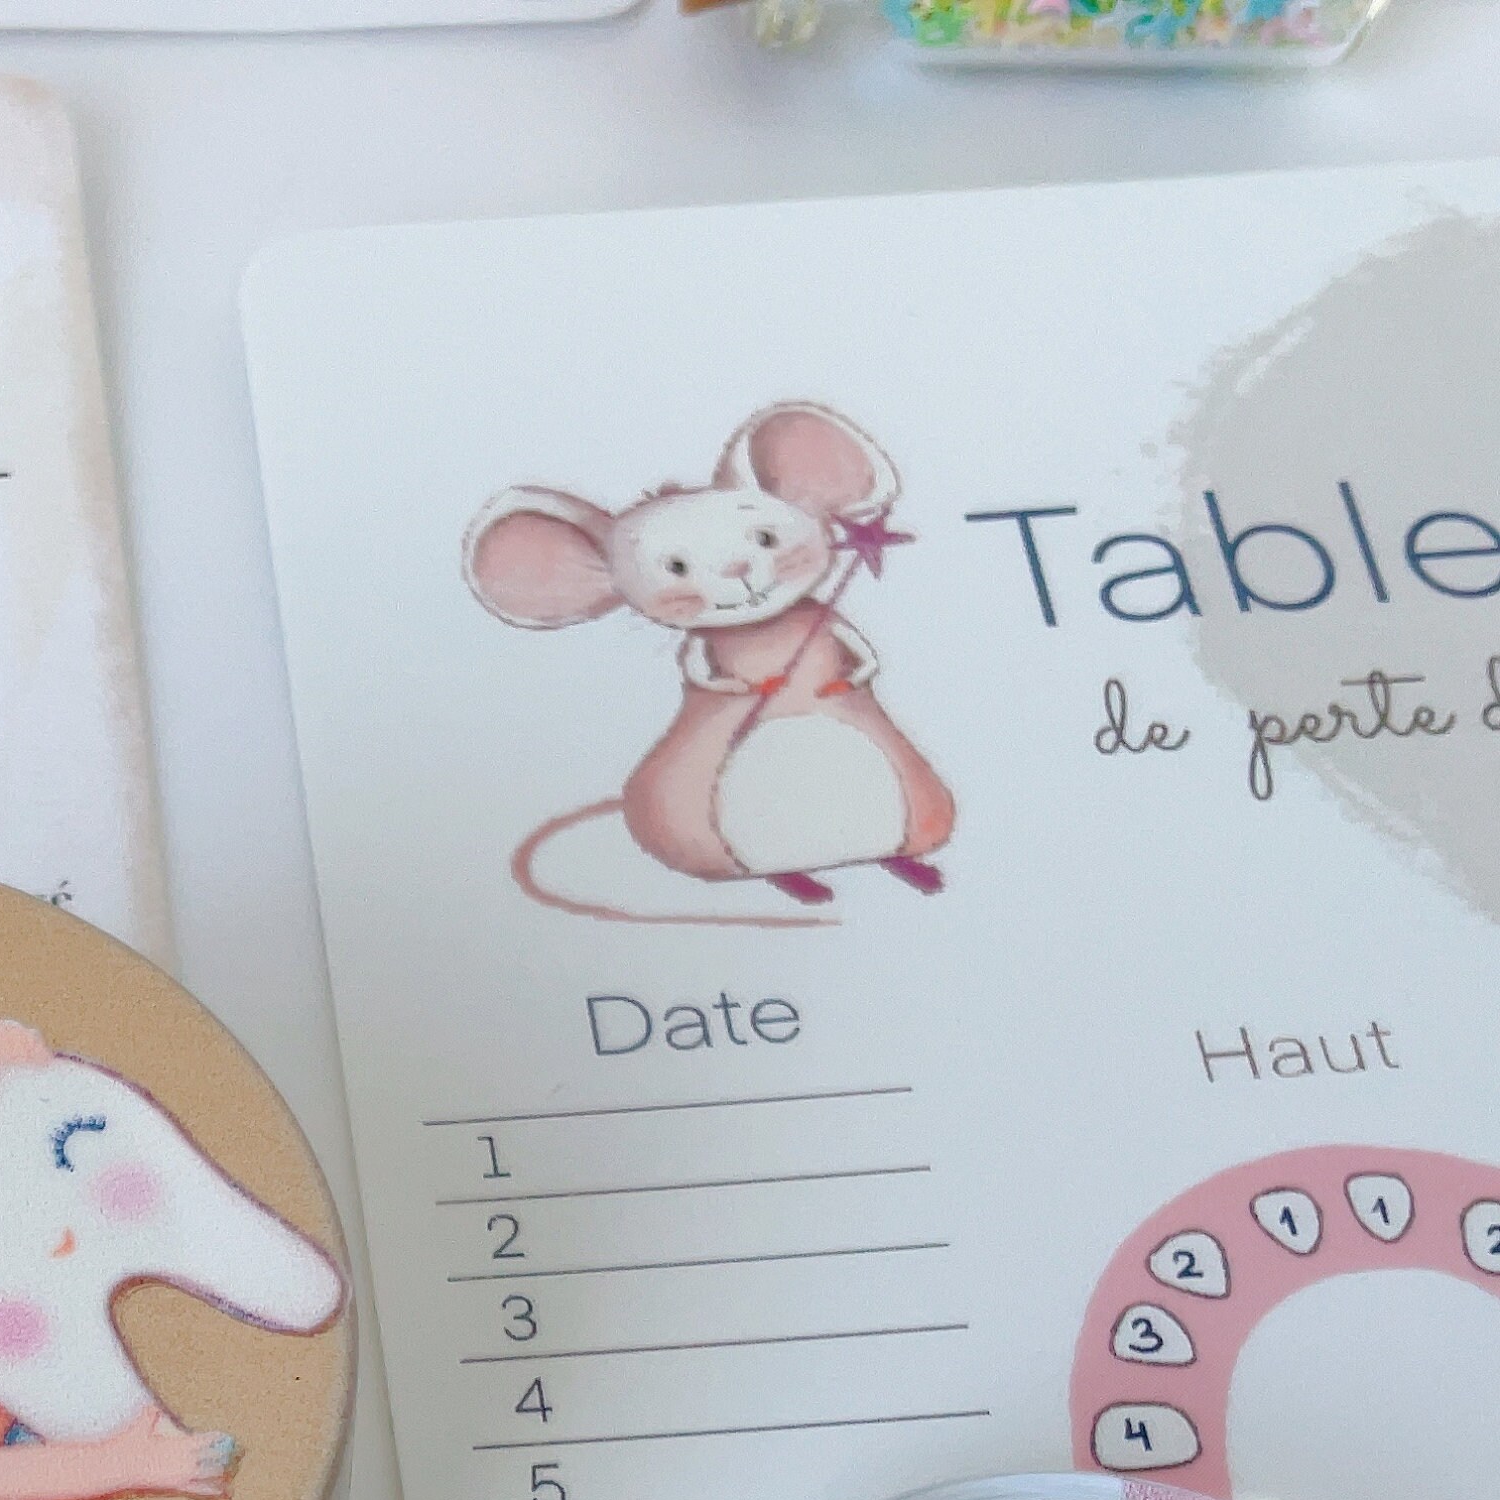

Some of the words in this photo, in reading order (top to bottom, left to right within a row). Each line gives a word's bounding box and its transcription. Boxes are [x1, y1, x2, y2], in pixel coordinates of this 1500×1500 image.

[1094, 678, 1190, 755] de
[1248, 670, 1457, 801] perte
[586, 991, 800, 1056] Date
[1196, 1021, 1399, 1083] Haut
[477, 1136, 511, 1179] 1
[1279, 1206, 1297, 1237] 1
[1373, 1197, 1390, 1224] 1
[487, 1214, 525, 1259] 2
[1173, 1250, 1204, 1279] 2
[502, 1295, 537, 1341] 3
[1128, 1317, 1163, 1353] 3
[515, 1377, 553, 1422] 4
[1125, 1418, 1152, 1451] 4
